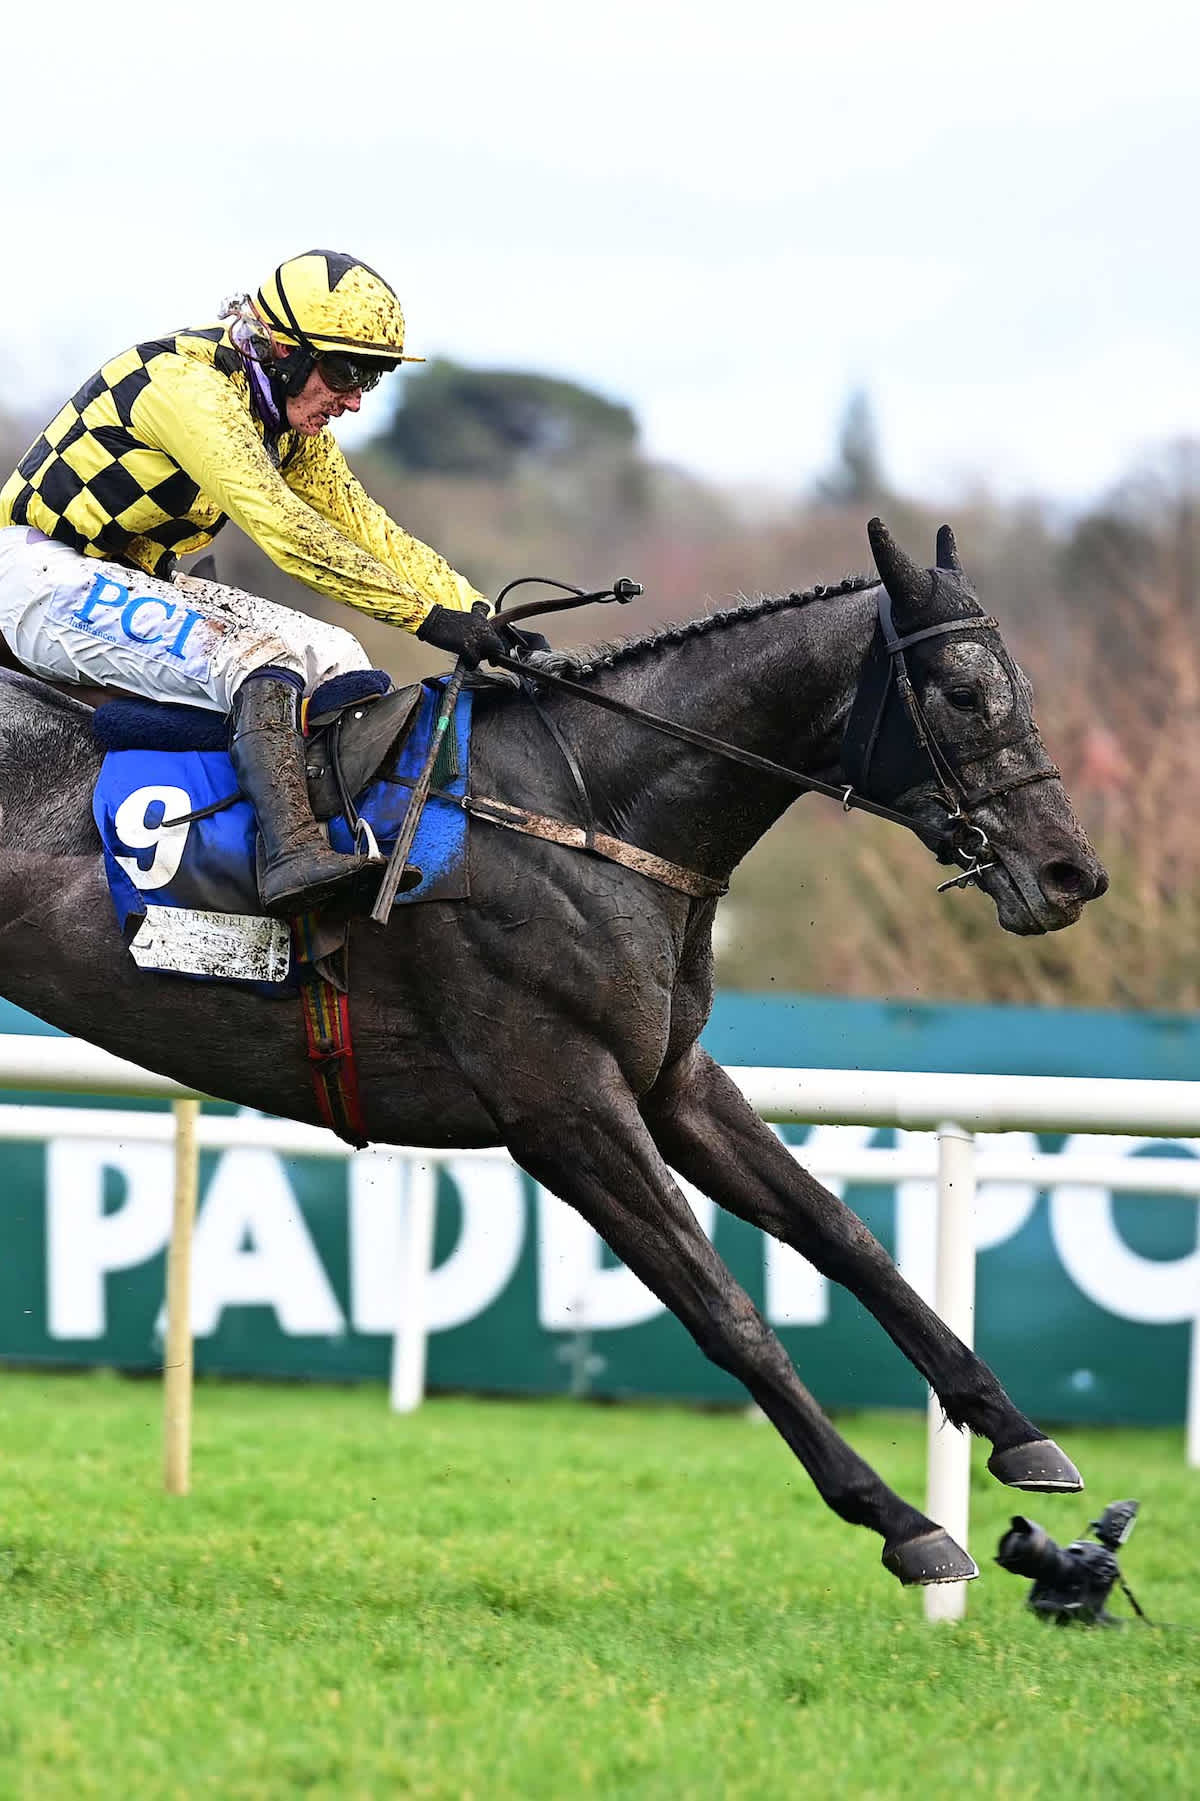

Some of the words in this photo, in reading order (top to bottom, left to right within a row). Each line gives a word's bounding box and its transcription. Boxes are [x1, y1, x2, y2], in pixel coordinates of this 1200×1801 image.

[69, 616, 117, 643] Insurances
[73, 572, 206, 660] PCI
[115, 785, 191, 890] 9
[164, 910, 244, 926] NATHANIEL
